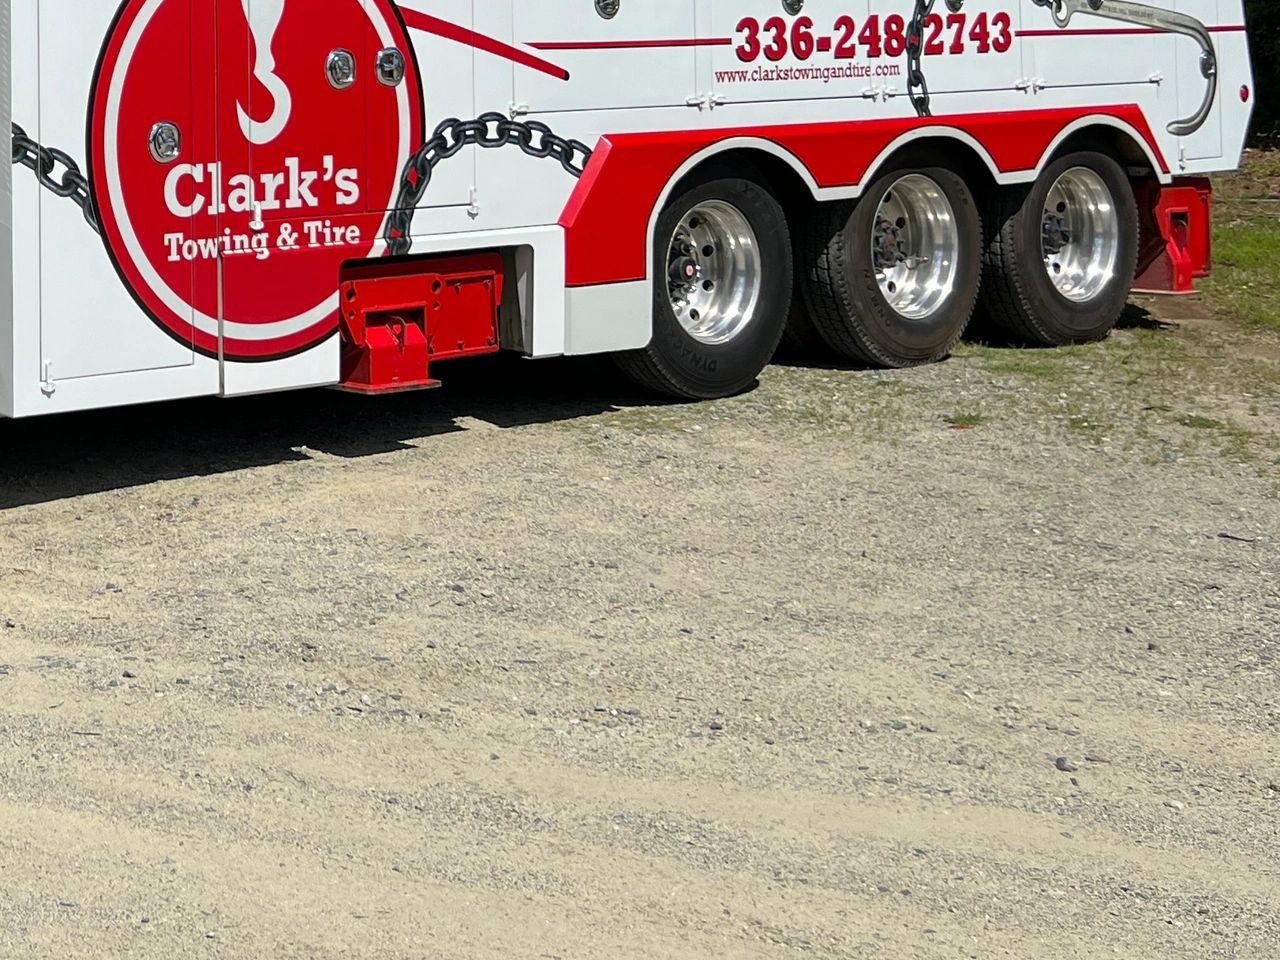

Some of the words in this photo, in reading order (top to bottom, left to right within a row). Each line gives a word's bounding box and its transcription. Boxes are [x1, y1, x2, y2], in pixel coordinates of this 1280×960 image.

[715, 62, 901, 84] www.clarkstowingandtire.com
[163, 155, 360, 218] Clark's
[164, 227, 270, 260] Towing
[276, 222, 300, 250] &
[304, 219, 361, 249] Tire
